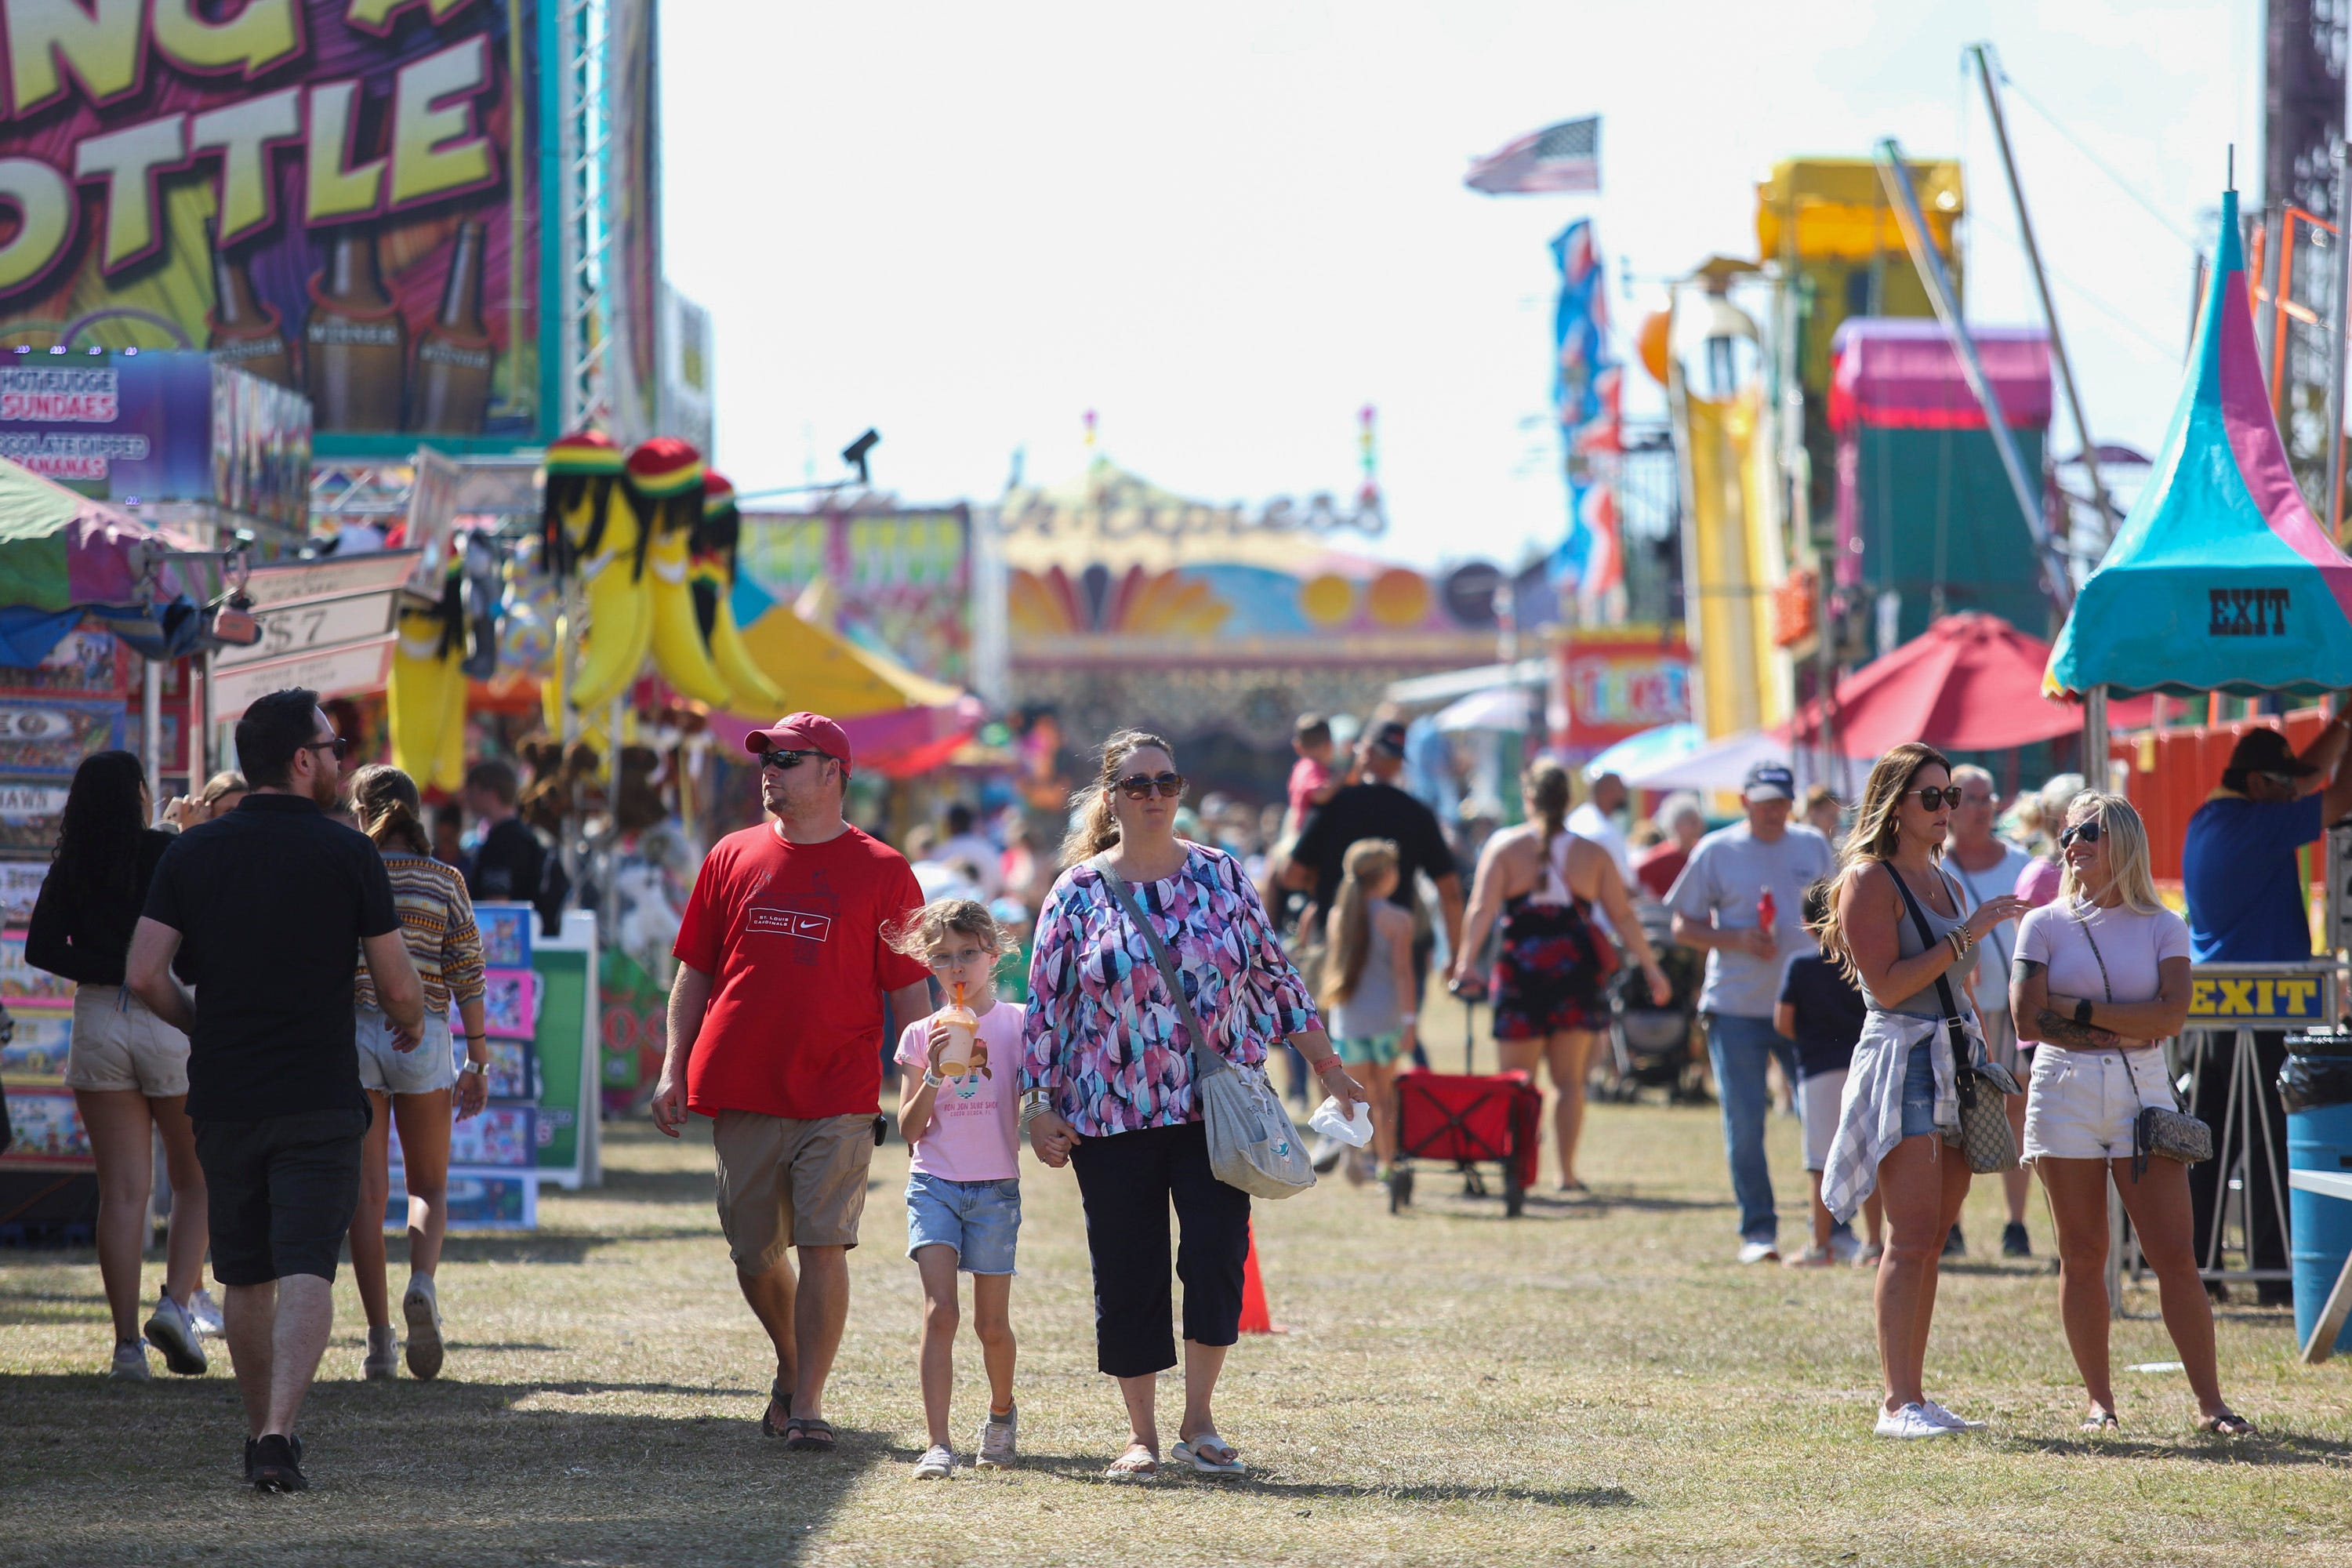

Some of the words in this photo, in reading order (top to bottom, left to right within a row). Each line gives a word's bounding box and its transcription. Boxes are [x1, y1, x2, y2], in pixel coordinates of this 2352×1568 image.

[2, 394, 115, 420] SUNDAES
[2209, 588, 2291, 637] EXIT
[265, 609, 327, 652] $7
[2187, 980, 2317, 1014] EXIT
[957, 1102, 968, 1111] JON
[970, 1102, 983, 1110] SURF
